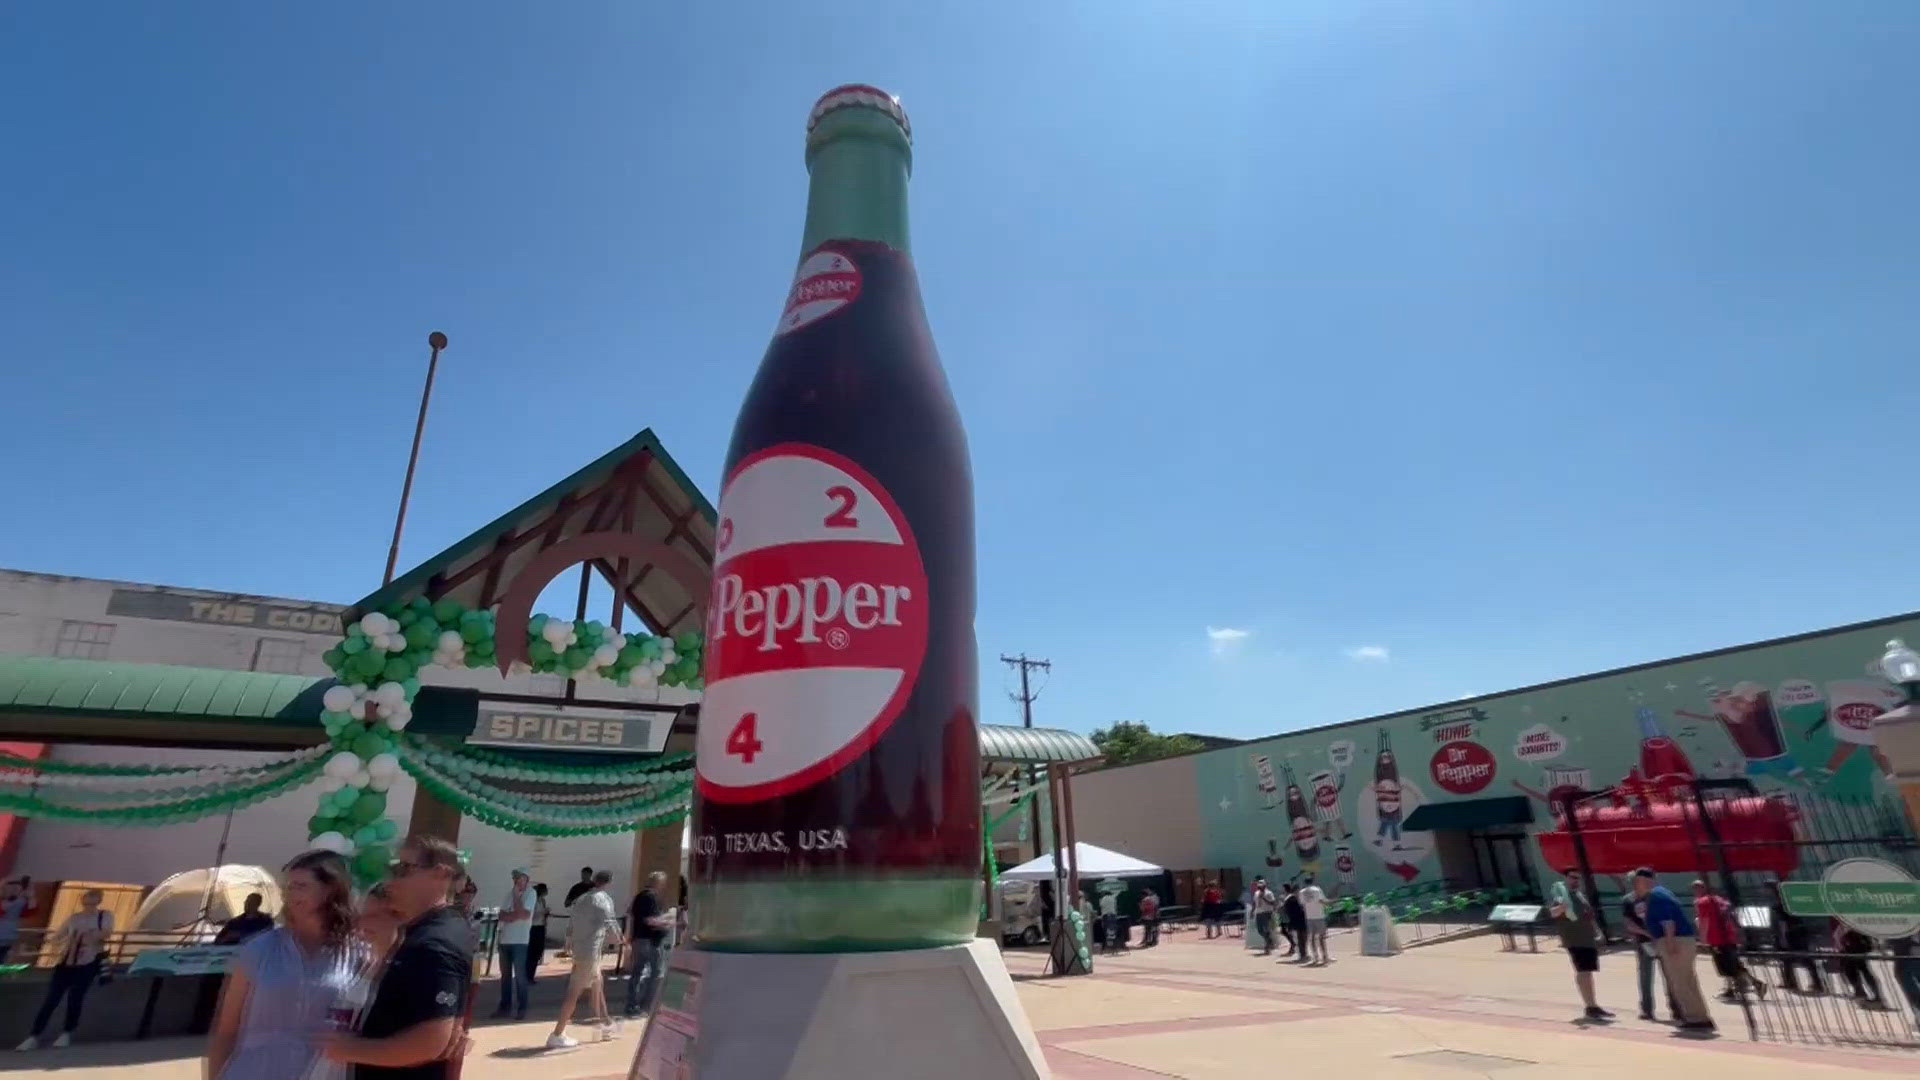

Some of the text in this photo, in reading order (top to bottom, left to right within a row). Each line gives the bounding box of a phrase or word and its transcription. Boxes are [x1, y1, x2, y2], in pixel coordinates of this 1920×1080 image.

[824, 485, 859, 529] 2
[191, 601, 256, 624] THE
[713, 573, 912, 652] Pepper
[489, 714, 625, 745] SPICES
[725, 712, 763, 764] 4
[799, 829, 849, 851] USA
